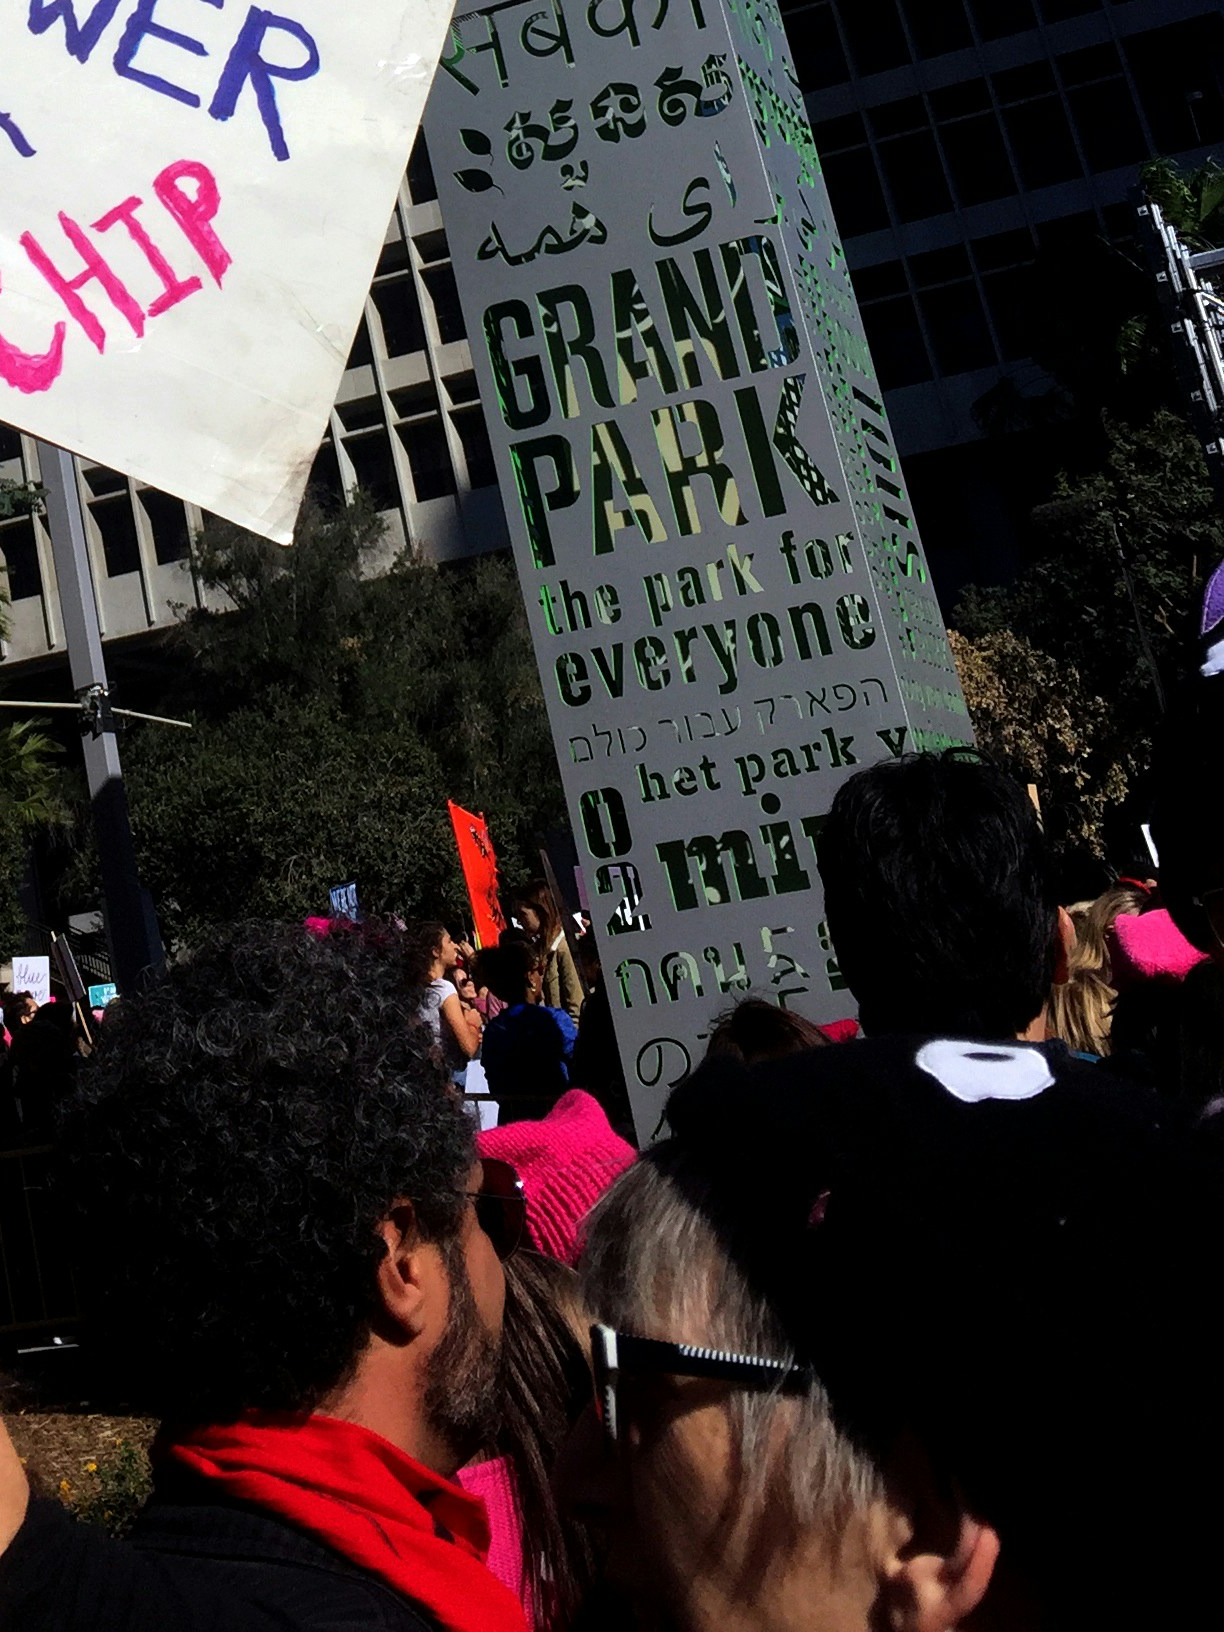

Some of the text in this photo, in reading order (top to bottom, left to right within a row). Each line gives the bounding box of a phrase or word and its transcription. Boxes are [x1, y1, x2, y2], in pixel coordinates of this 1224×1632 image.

[482, 235, 801, 431] GRAND
[508, 373, 841, 569] PARK
[538, 530, 855, 636] the park for
[554, 593, 877, 708] everyone
[568, 723, 648, 763] כולם
[754, 677, 889, 736] הפארק
[634, 755, 722, 804] het
[734, 726, 862, 797] park
